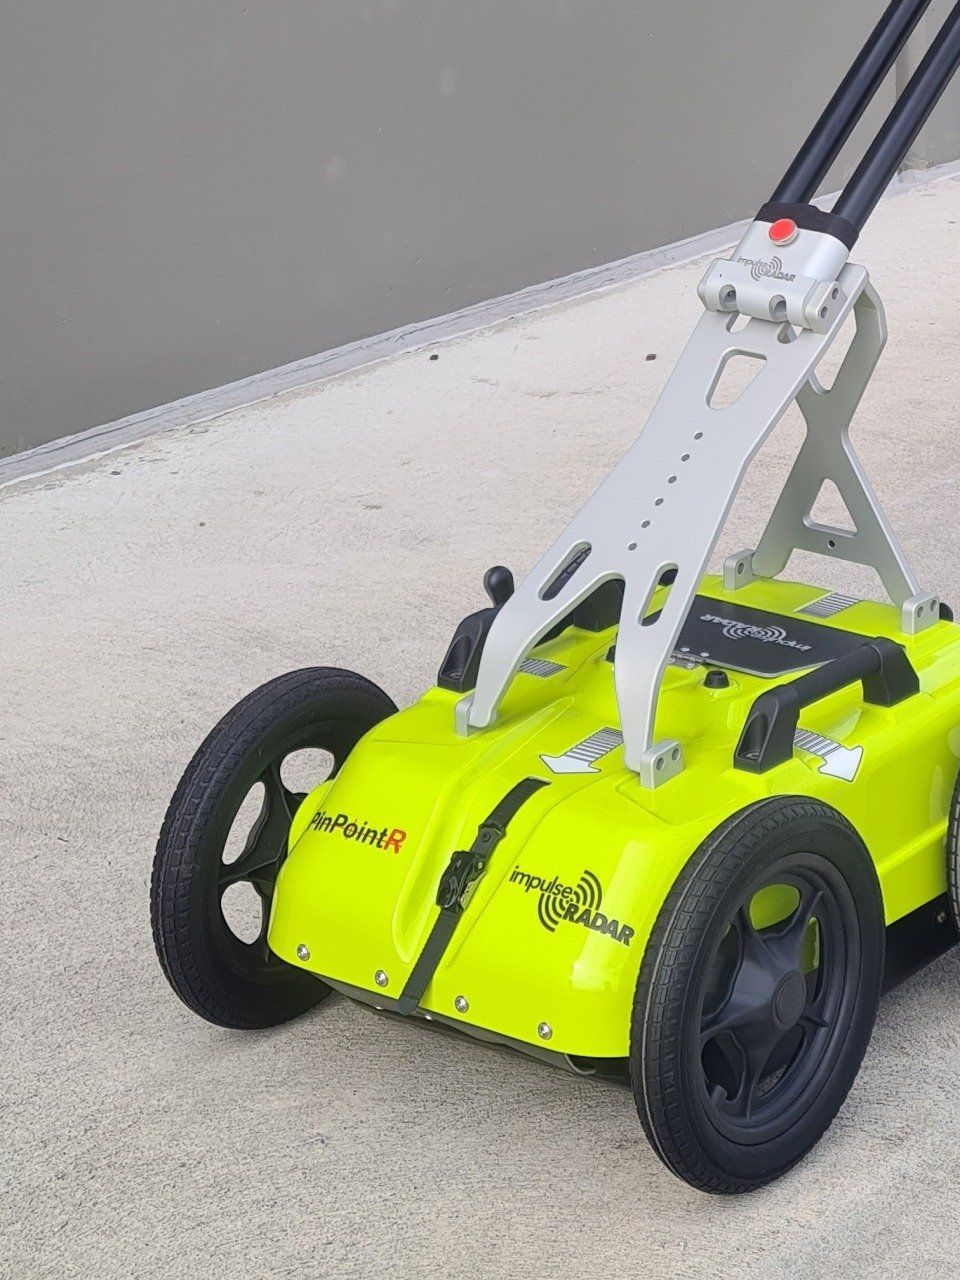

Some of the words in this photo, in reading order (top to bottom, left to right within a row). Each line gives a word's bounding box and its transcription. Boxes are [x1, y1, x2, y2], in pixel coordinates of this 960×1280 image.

[763, 269, 796, 282] RADAR
[310, 811, 407, 854] PinPointR
[509, 865, 573, 899] impulse
[562, 902, 635, 947] RADAR
